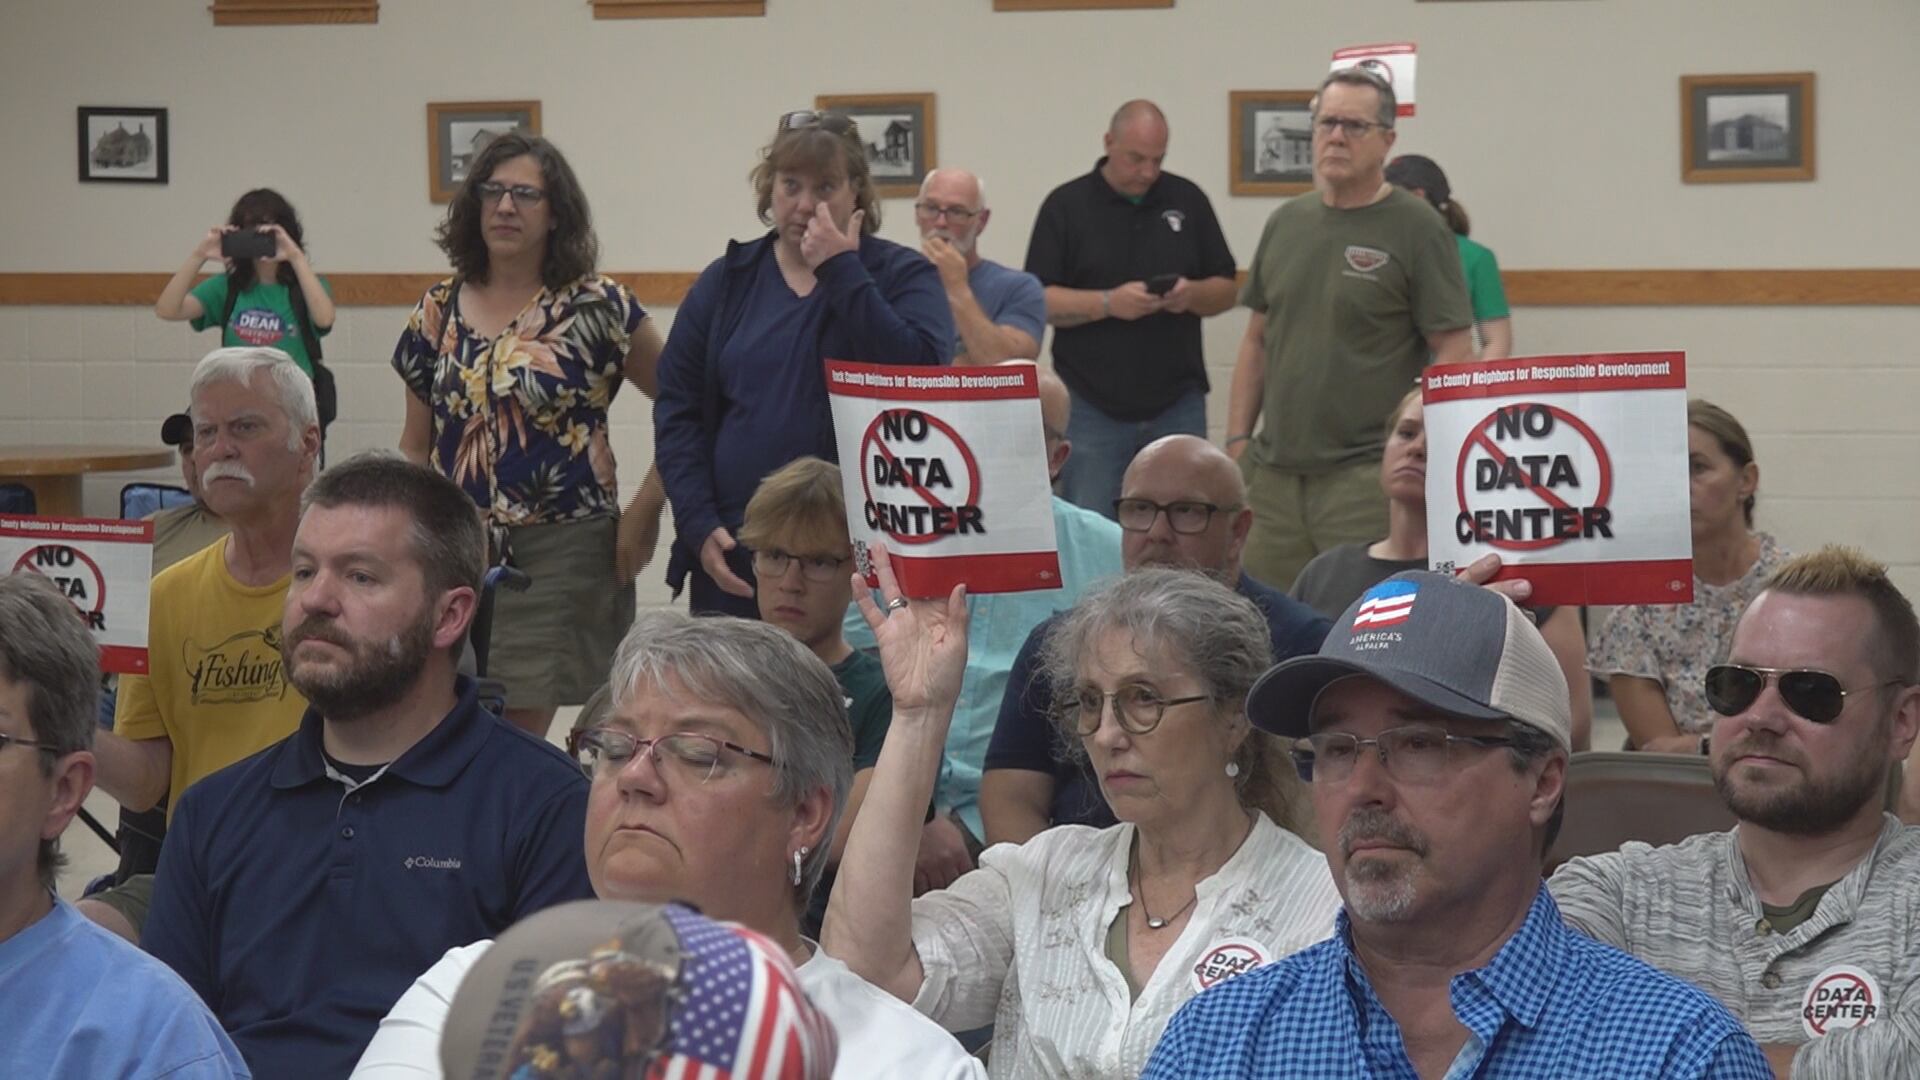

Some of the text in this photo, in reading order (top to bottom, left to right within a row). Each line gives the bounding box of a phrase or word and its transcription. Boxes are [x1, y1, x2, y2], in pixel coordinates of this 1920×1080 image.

[240, 314, 280, 330] DEAN
[865, 372, 894, 388] Neighbors
[894, 375, 907, 388] for
[907, 375, 960, 390] Responsible
[961, 373, 1025, 389] Development
[1443, 372, 1471, 388] County
[1472, 368, 1515, 386] Neighbors
[1516, 367, 1530, 380] for
[1531, 362, 1596, 380] Responsible
[1598, 361, 1670, 378] Development
[882, 410, 929, 442] NO
[1495, 404, 1554, 440] NO
[873, 454, 953, 489] DATA
[1475, 454, 1579, 492] DATA
[864, 500, 986, 536] CENTER
[1455, 505, 1614, 546] CENTER
[36, 545, 75, 567] NO
[54, 577, 87, 599] TA
[1349, 631, 1403, 645] AMERICA'S
[1355, 642, 1389, 651] ALFALFA
[203, 649, 281, 692] Fishing
[415, 855, 461, 868] Columbia
[1817, 988, 1867, 1002] DATA
[1803, 1004, 1877, 1019] CENTER
